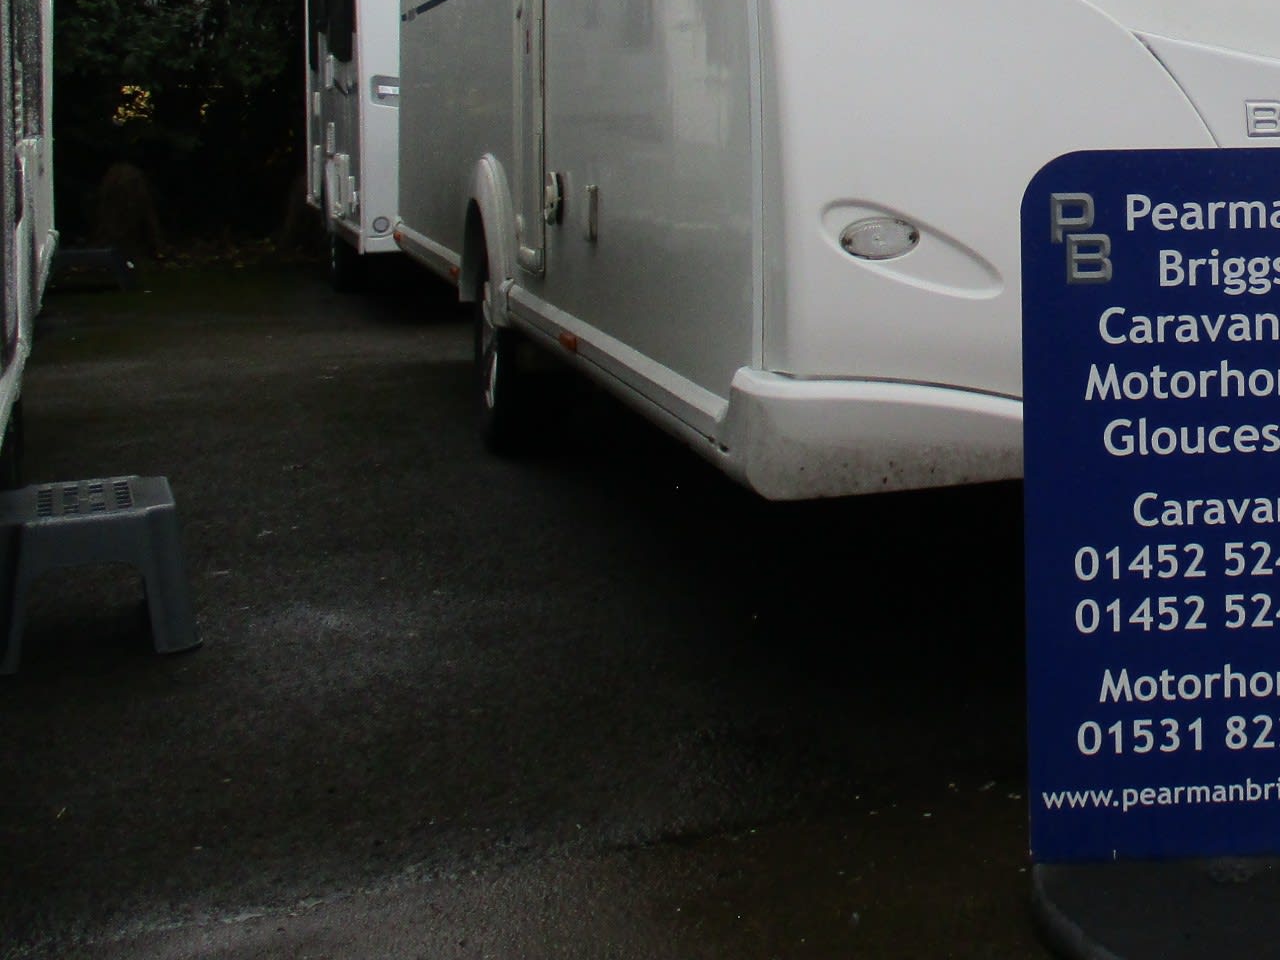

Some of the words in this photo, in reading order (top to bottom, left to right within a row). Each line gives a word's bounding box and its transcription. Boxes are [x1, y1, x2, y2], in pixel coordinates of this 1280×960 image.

[1073, 543, 1207, 582] 01452
[1074, 595, 1208, 634] 01452
[1076, 717, 1205, 756] 01531
